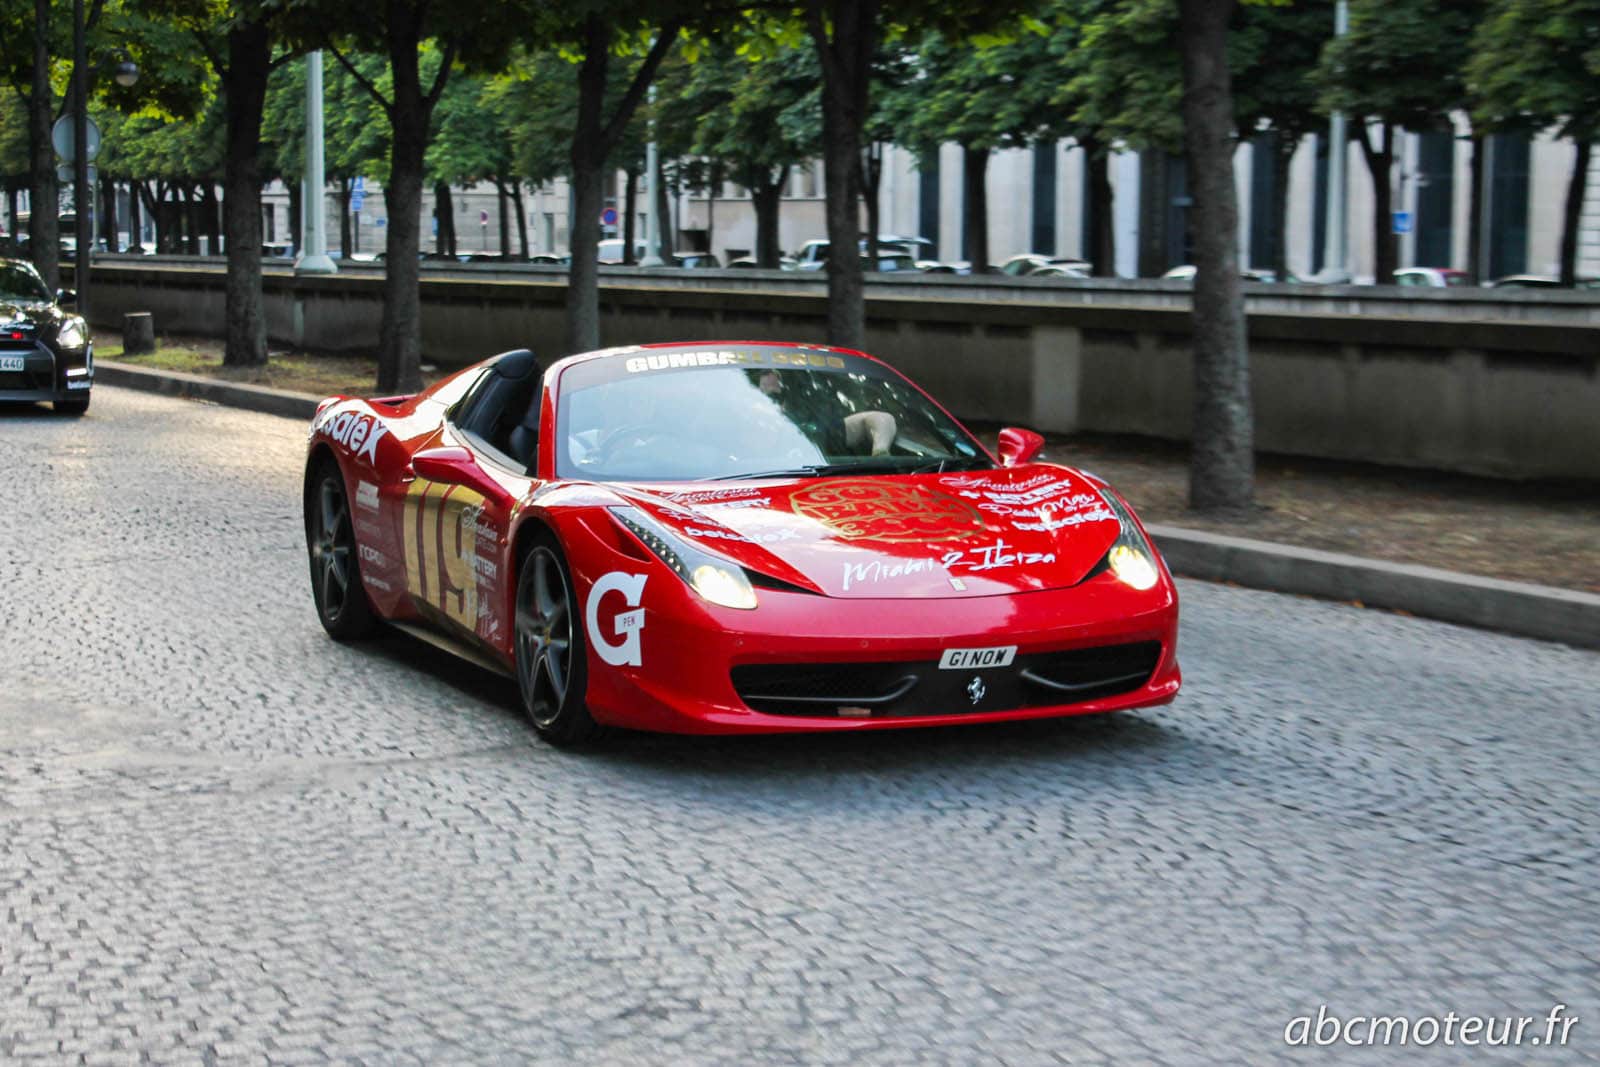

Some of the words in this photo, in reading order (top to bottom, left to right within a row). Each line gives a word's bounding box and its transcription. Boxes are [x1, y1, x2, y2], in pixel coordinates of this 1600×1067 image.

[842, 557, 934, 592] Miami
[941, 551, 977, 569] 2
[968, 538, 1056, 571] Ibiza
[586, 571, 649, 667] G
